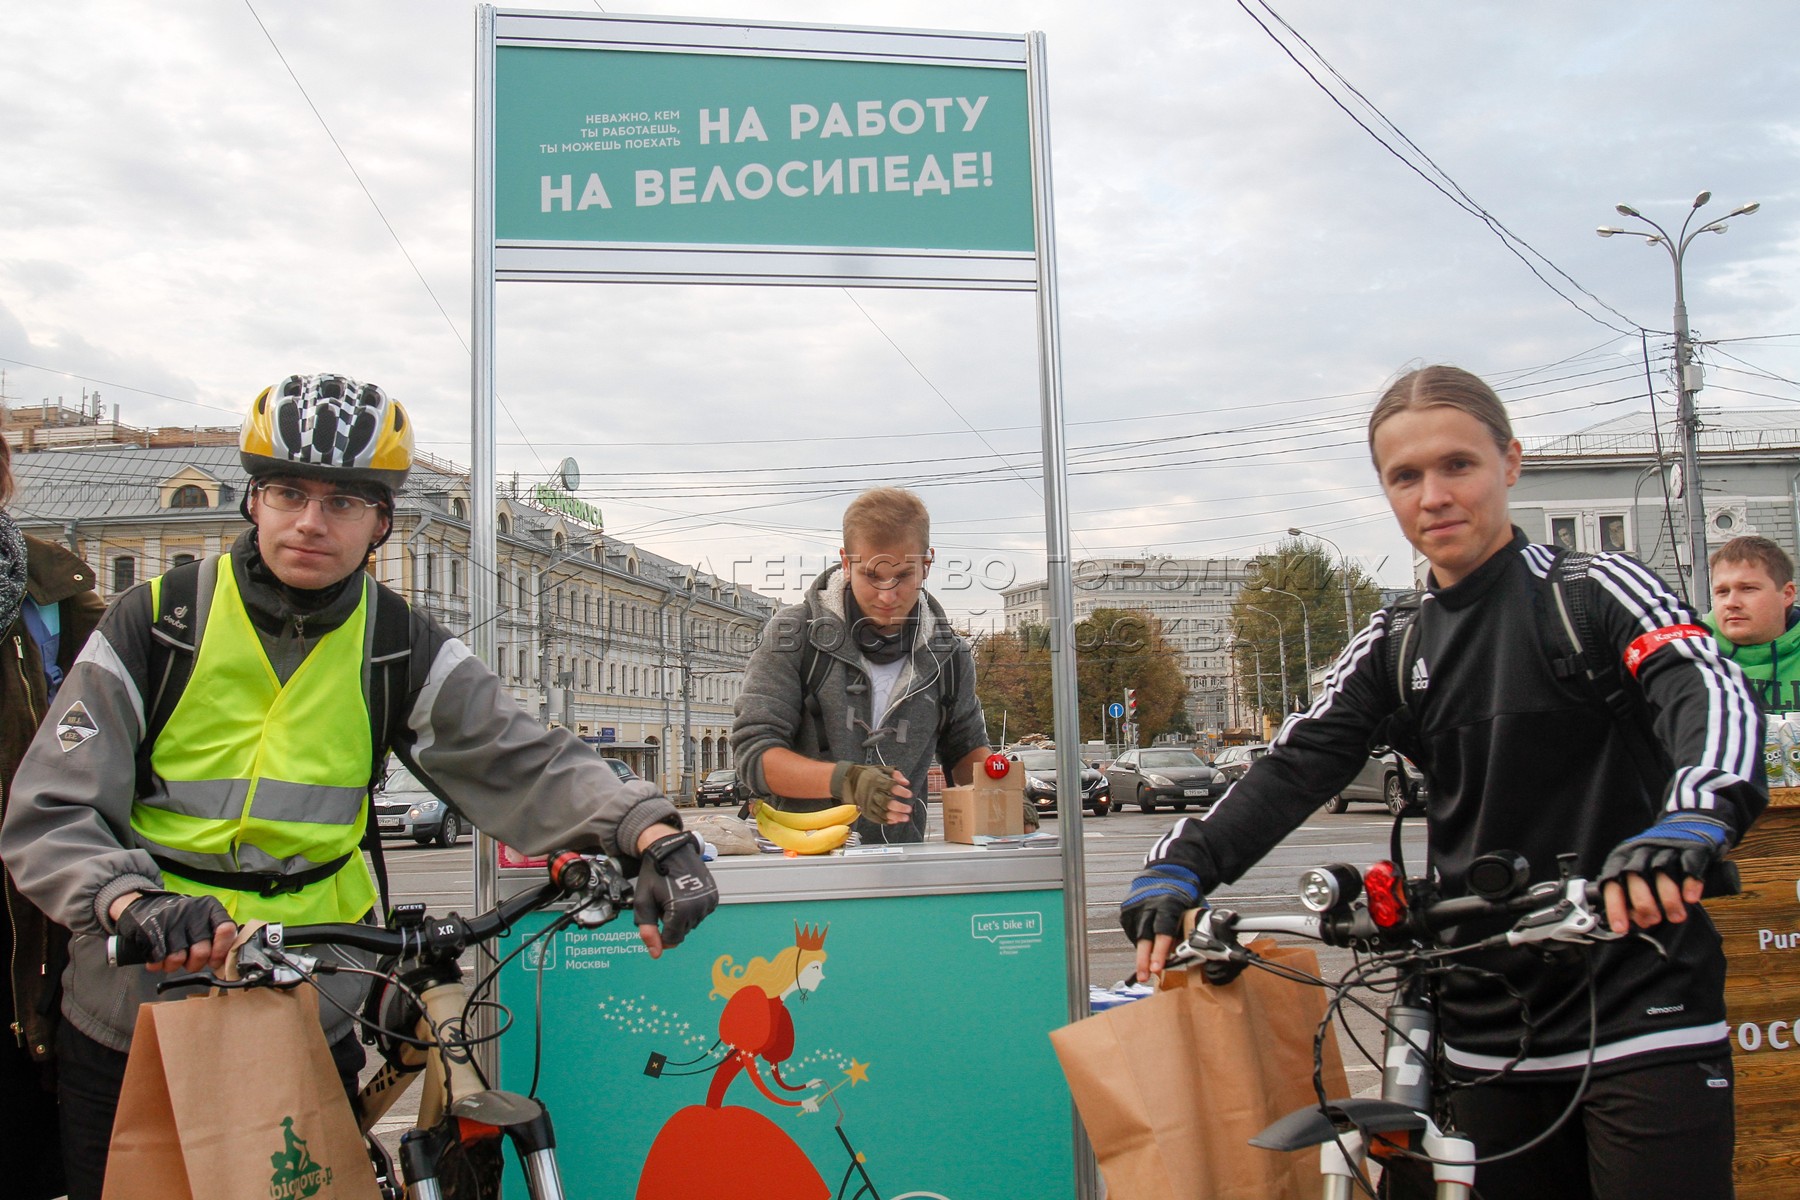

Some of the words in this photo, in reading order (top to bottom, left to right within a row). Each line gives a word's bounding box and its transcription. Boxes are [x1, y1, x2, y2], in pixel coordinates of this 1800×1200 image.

[586, 112, 650, 124] НЕВАЖНО,
[655, 110, 680, 120] КЕМ
[700, 106, 768, 145] НА
[790, 96, 989, 140] РАБОТУ
[581, 128, 598, 138] ТЫ
[602, 124, 681, 136] РАБОТАЕШЬ,
[540, 144, 558, 154] ТЫ
[562, 141, 621, 152] МОЖЕШЬ
[625, 137, 681, 149] ПОЕХАТЬ
[541, 173, 612, 213] НА
[635, 151, 993, 207] ВЕЛОСИПЕДЕ!
[163, 614, 188, 630] deuter
[993, 761, 1005, 771] hh
[675, 873, 704, 891] F3
[438, 924, 454, 936] XR
[978, 920, 1000, 931] Let's
[1002, 919, 1023, 930] bike
[1025, 919, 1035, 929] it!
[565, 932, 588, 944] При
[591, 931, 641, 942] поддерж
[565, 960, 610, 970] Москвы
